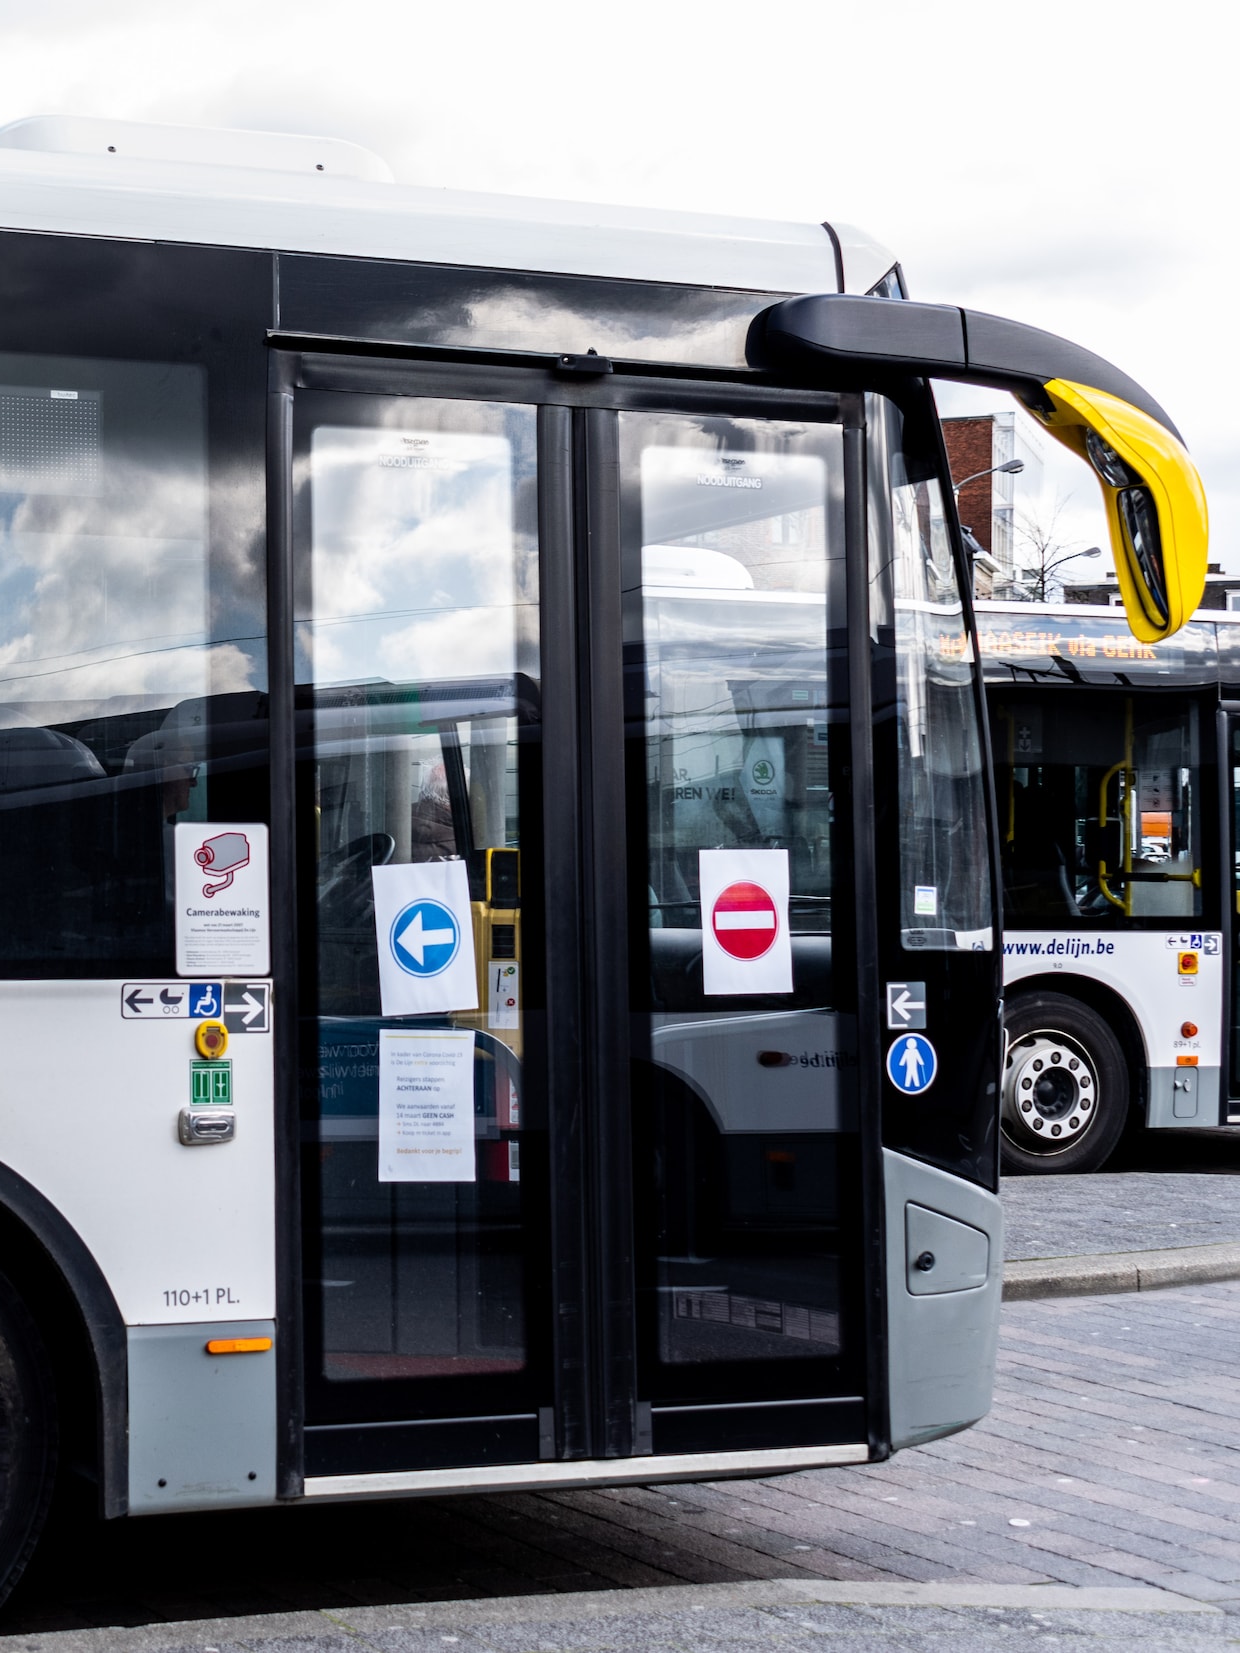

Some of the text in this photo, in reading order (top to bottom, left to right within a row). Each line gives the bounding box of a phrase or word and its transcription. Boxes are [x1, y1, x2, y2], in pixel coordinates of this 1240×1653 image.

[697, 475, 762, 489] NOODUITGANG
[1067, 634, 1096, 657] via
[186, 908, 260, 918] Camerabewaking
[1002, 938, 1115, 958] www.delijn.be
[163, 1287, 240, 1307] 110+1 PL.
